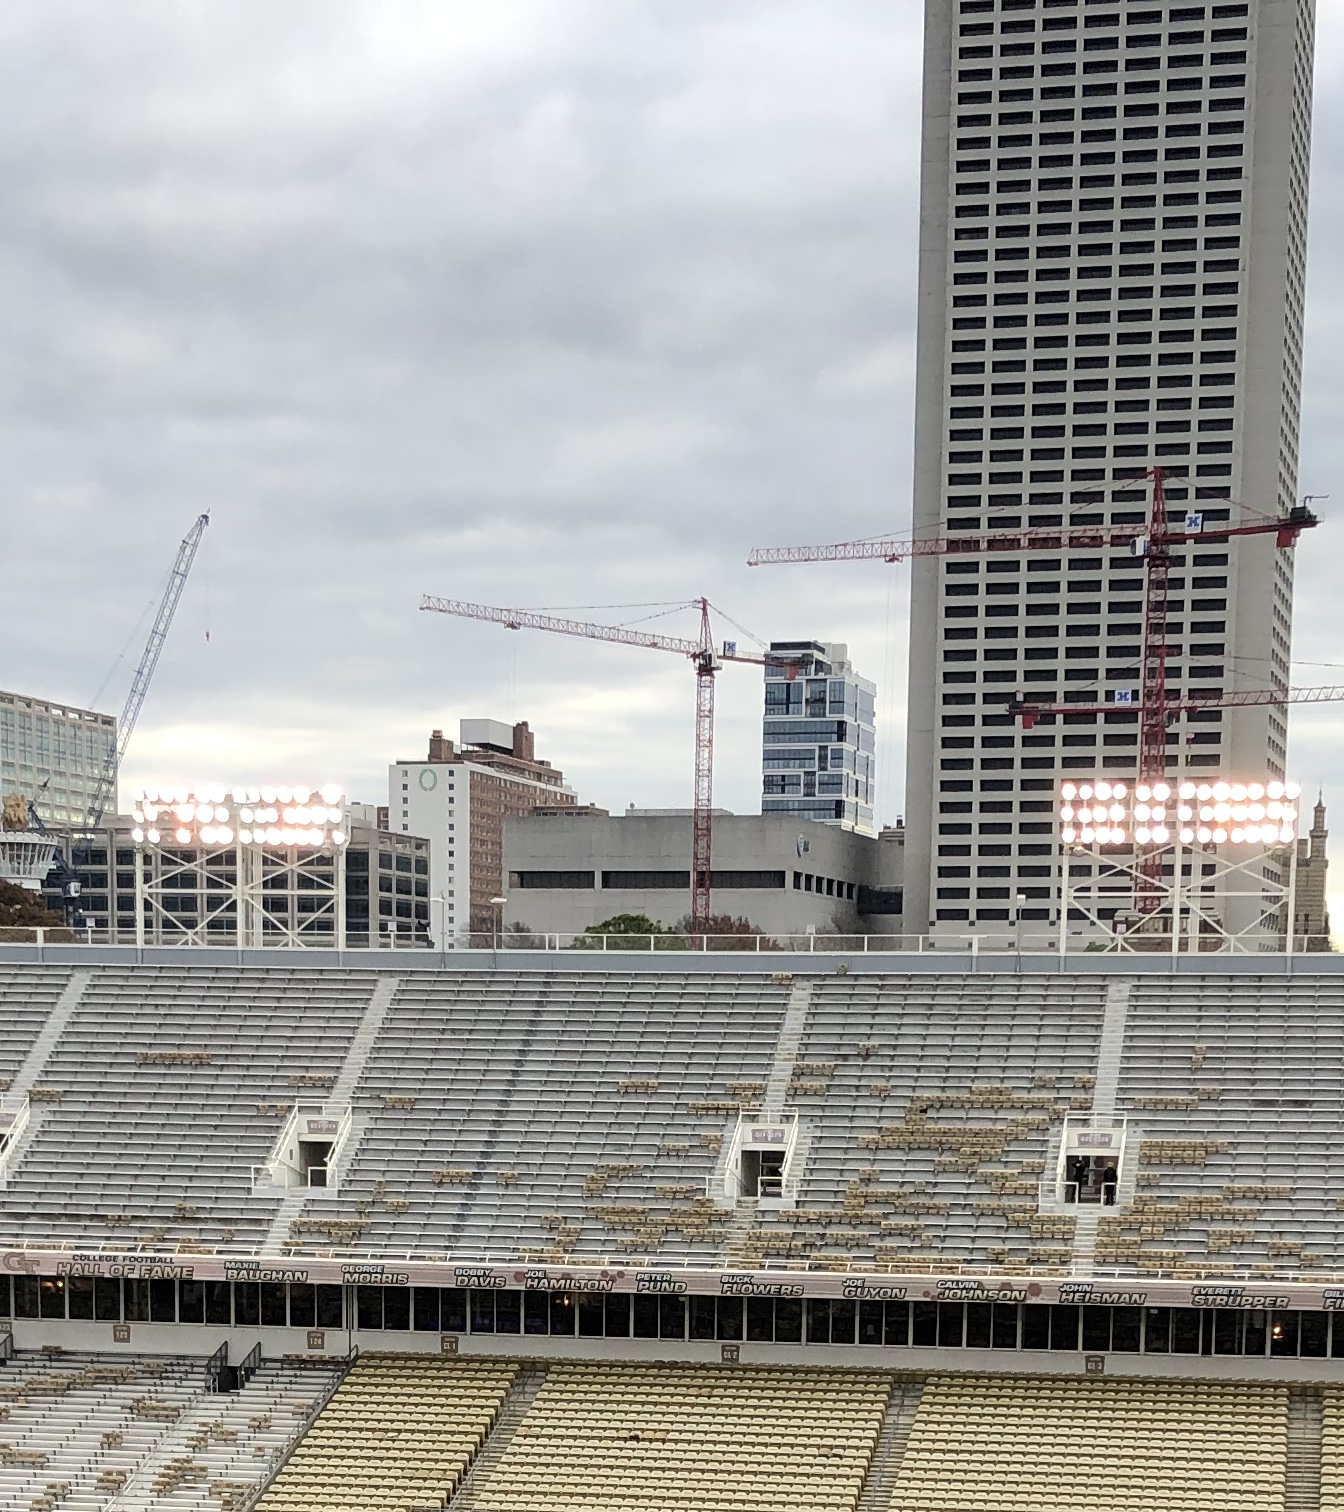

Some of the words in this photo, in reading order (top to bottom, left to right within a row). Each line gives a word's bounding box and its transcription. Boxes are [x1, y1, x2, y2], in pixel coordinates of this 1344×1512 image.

[72, 1254, 119, 1262] COLLEGE
[123, 1256, 174, 1264] FOOTBALL
[57, 1262, 104, 1277] HALL
[110, 1264, 136, 1278] OF
[140, 1265, 194, 1279] FAME
[224, 1261, 260, 1270] MAXIE
[342, 1265, 384, 1273] GEORGE
[226, 1269, 308, 1282] BAUGHAN
[455, 1268, 493, 1276] BOBBY
[525, 1270, 546, 1278] JOE
[636, 1273, 671, 1281] PETER
[342, 1272, 408, 1285] MORRIS
[456, 1276, 506, 1288] DAVIS
[526, 1278, 613, 1290] HAMILTON
[721, 1275, 752, 1284] BUCK
[842, 1278, 865, 1286] JOE
[637, 1281, 687, 1293] PUND
[721, 1283, 804, 1296] FLOWERS
[937, 1281, 978, 1289] CALVIN
[1059, 1284, 1093, 1292] JOHN
[843, 1286, 907, 1299] GUYON
[939, 1289, 1026, 1301] JOHNSON
[1192, 1287, 1245, 1295] EVERETT
[1060, 1292, 1146, 1304] HEISMAN
[1192, 1295, 1290, 1308] STRUPPER
